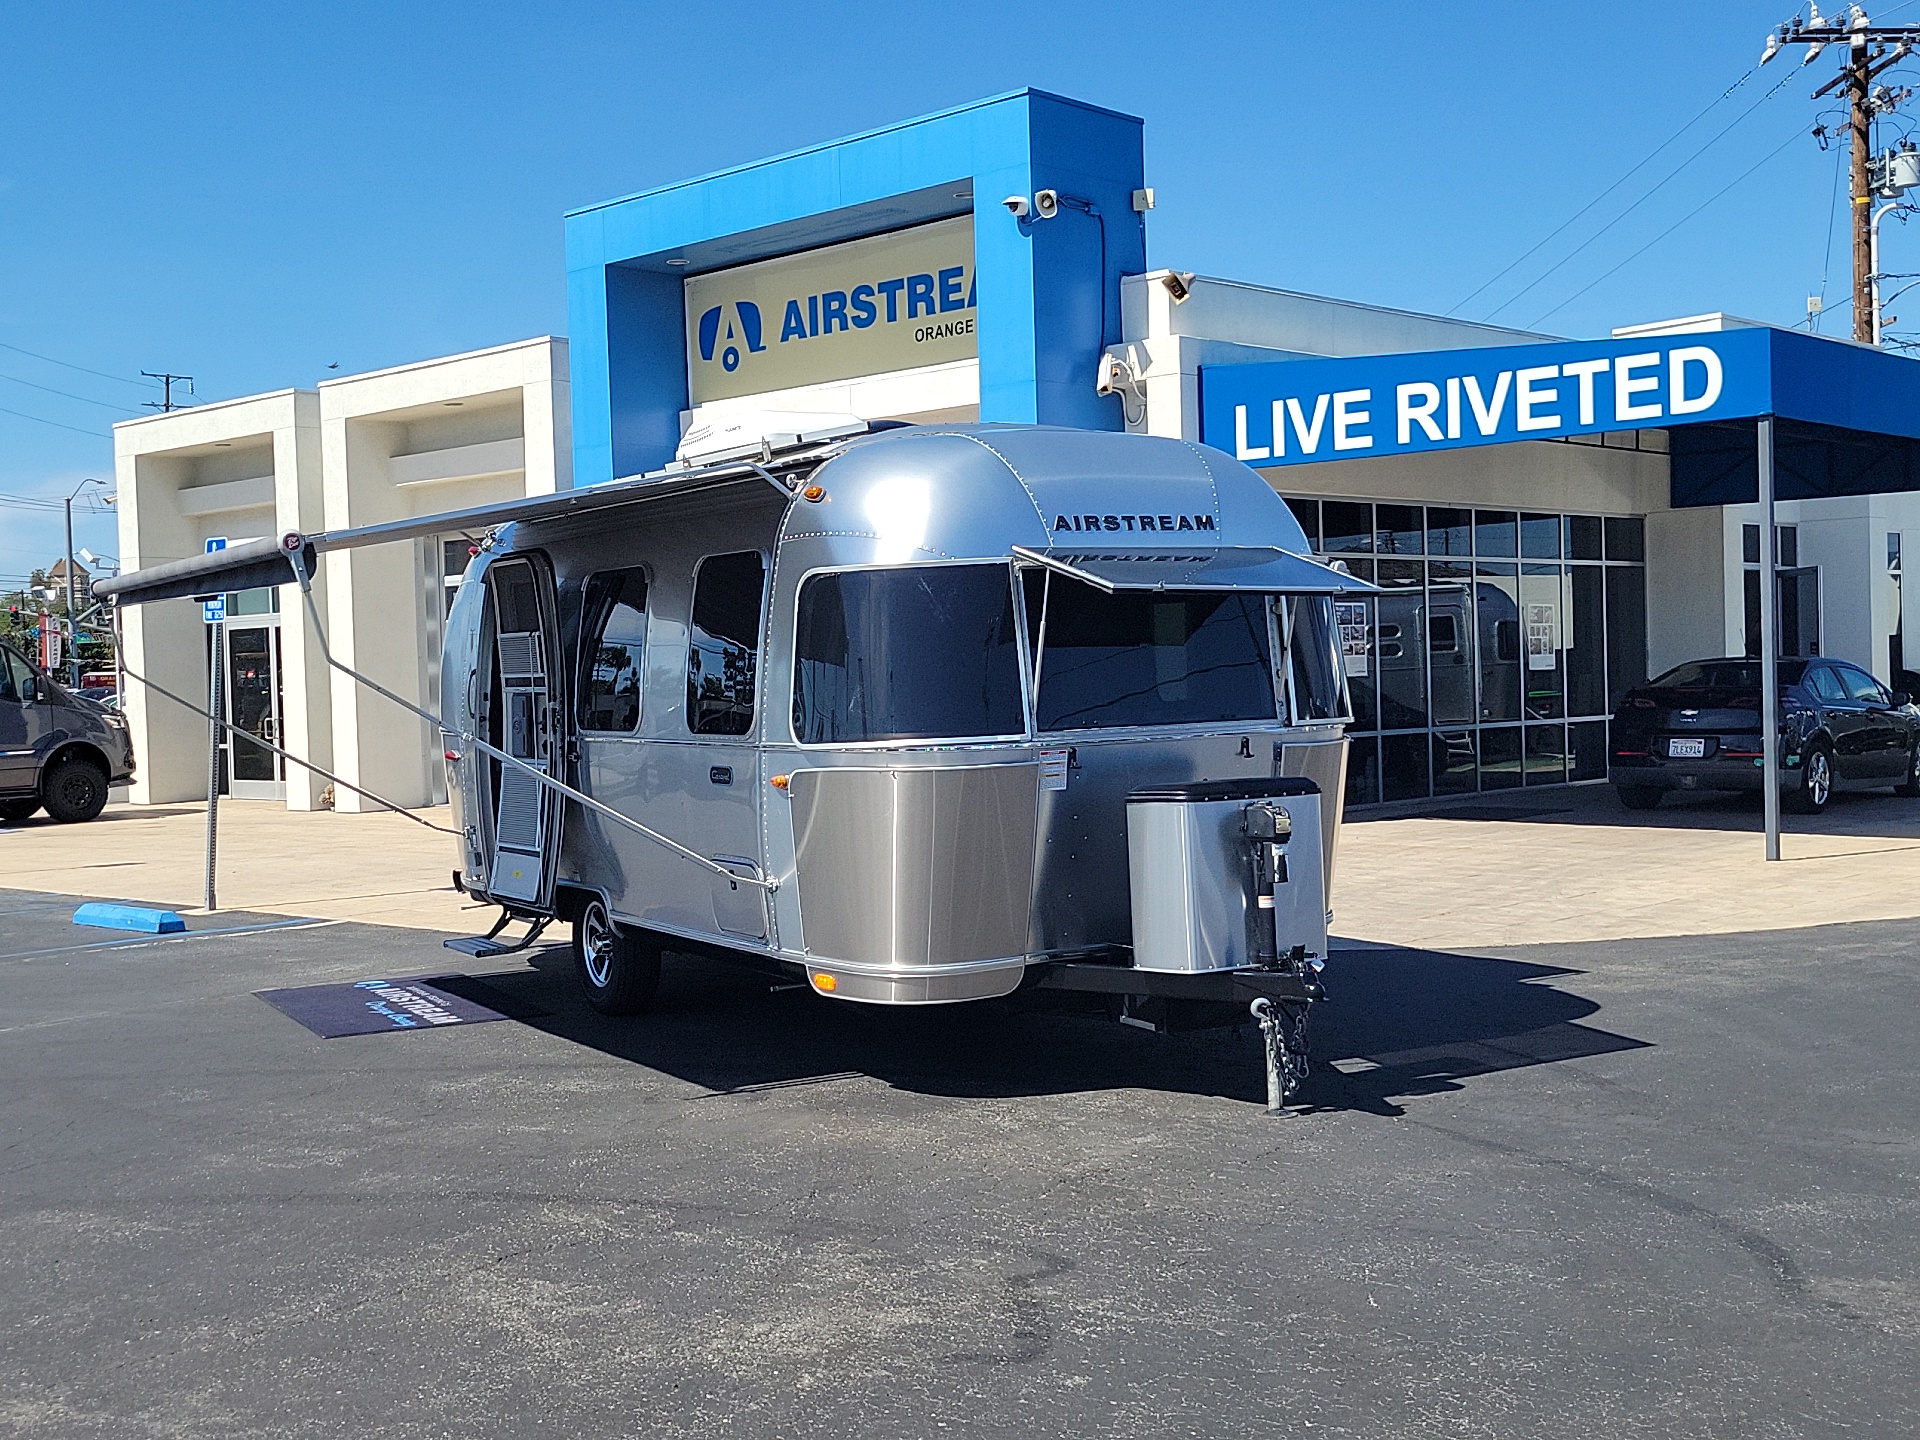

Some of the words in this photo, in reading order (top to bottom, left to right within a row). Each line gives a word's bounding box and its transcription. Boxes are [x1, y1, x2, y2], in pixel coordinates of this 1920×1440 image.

[914, 319, 974, 343] ORANGE
[1234, 388, 1373, 461] LIVE
[1396, 345, 1724, 445] RIVETED
[1053, 514, 1215, 532] AIRSTREAM
[370, 987, 463, 1025] AIRSTREAM
